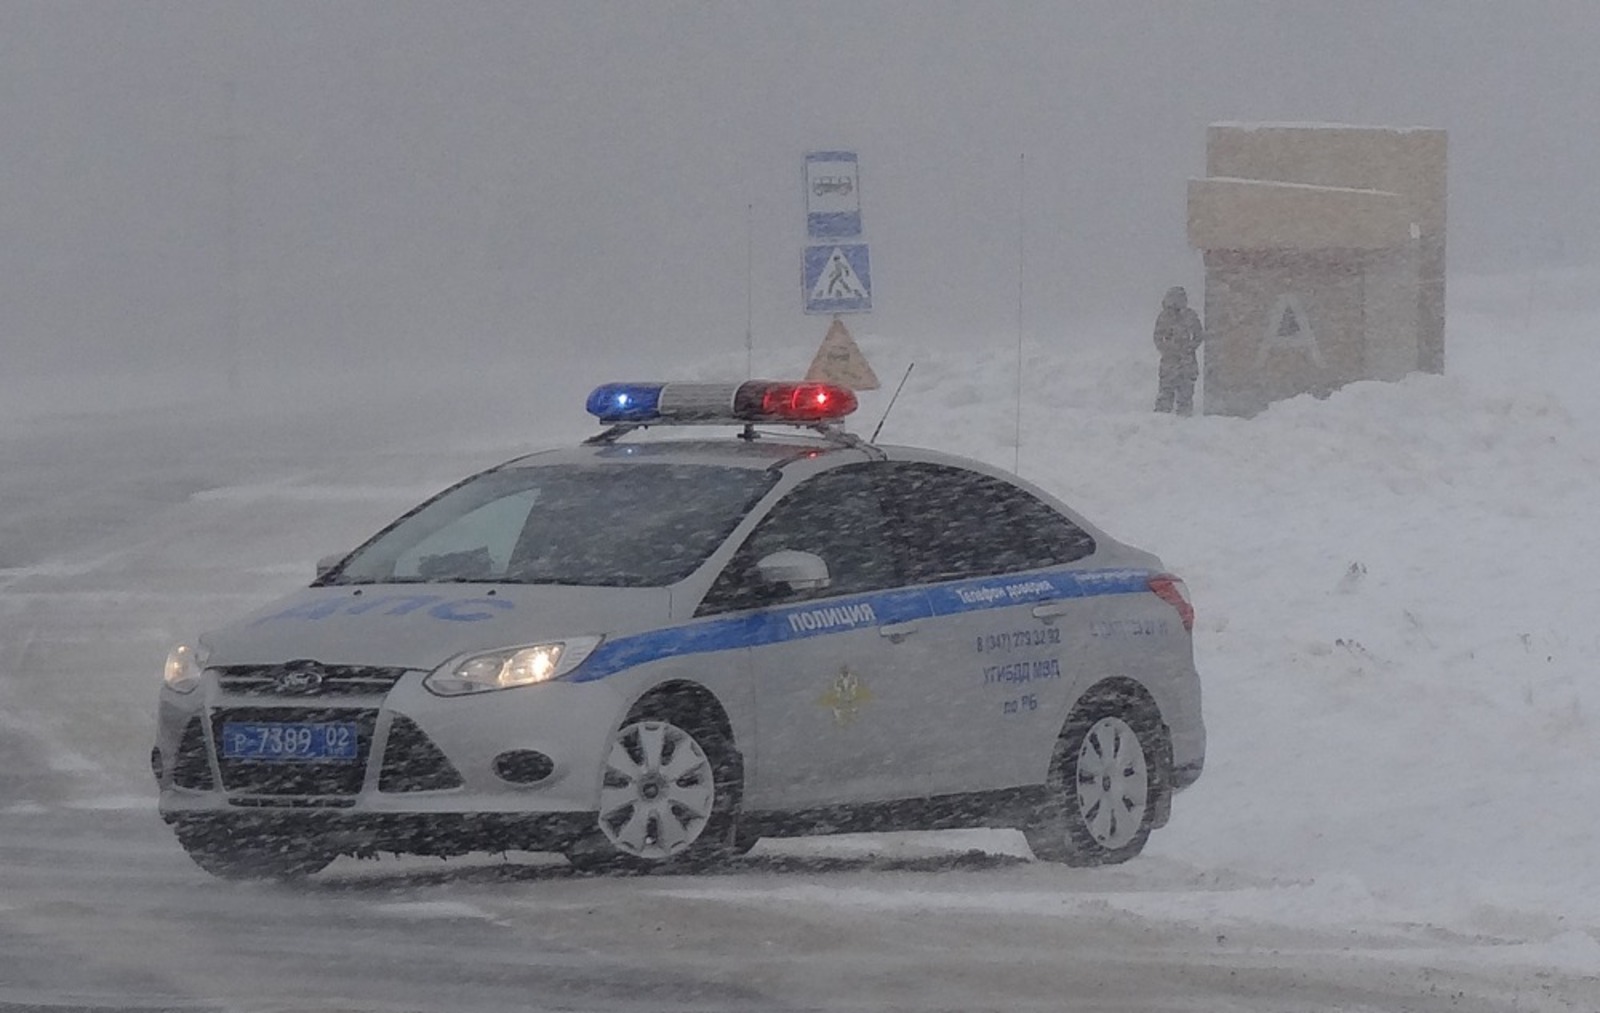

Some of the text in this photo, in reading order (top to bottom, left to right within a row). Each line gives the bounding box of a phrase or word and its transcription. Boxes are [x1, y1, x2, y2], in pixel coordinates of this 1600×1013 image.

[788, 603, 877, 632] ПОЛИЦИЯ
[1033, 658, 1062, 679] МВД
[255, 727, 312, 753] 7389
[325, 726, 350, 747] 02
